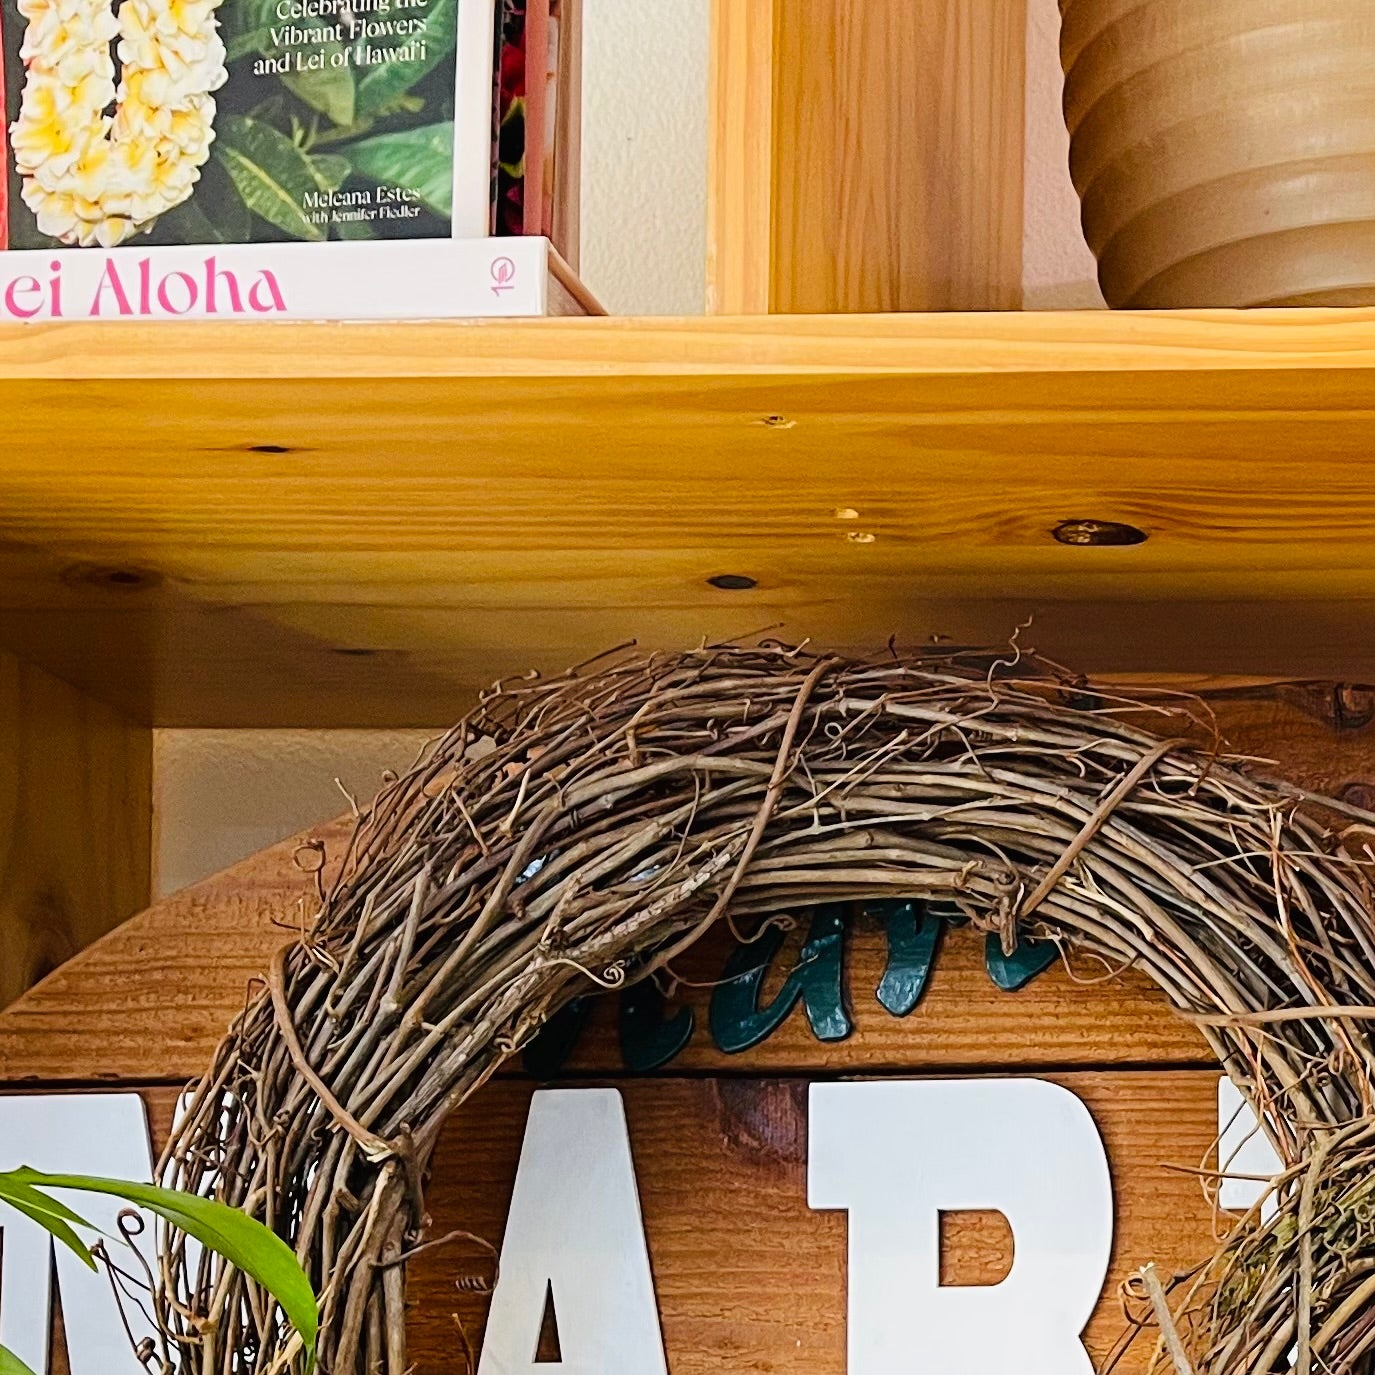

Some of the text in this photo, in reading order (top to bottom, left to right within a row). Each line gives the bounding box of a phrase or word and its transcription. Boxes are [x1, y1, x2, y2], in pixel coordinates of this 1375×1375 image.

[276, 0, 390, 20] Celebrating
[270, 18, 428, 47] Vibrant Flowers
[253, 52, 290, 75] and
[296, 49, 325, 71] Lei
[330, 46, 353, 67] of
[302, 186, 421, 209] Meleana Estes
[302, 210, 328, 224] with
[4, 256, 288, 318] ei Aloha
